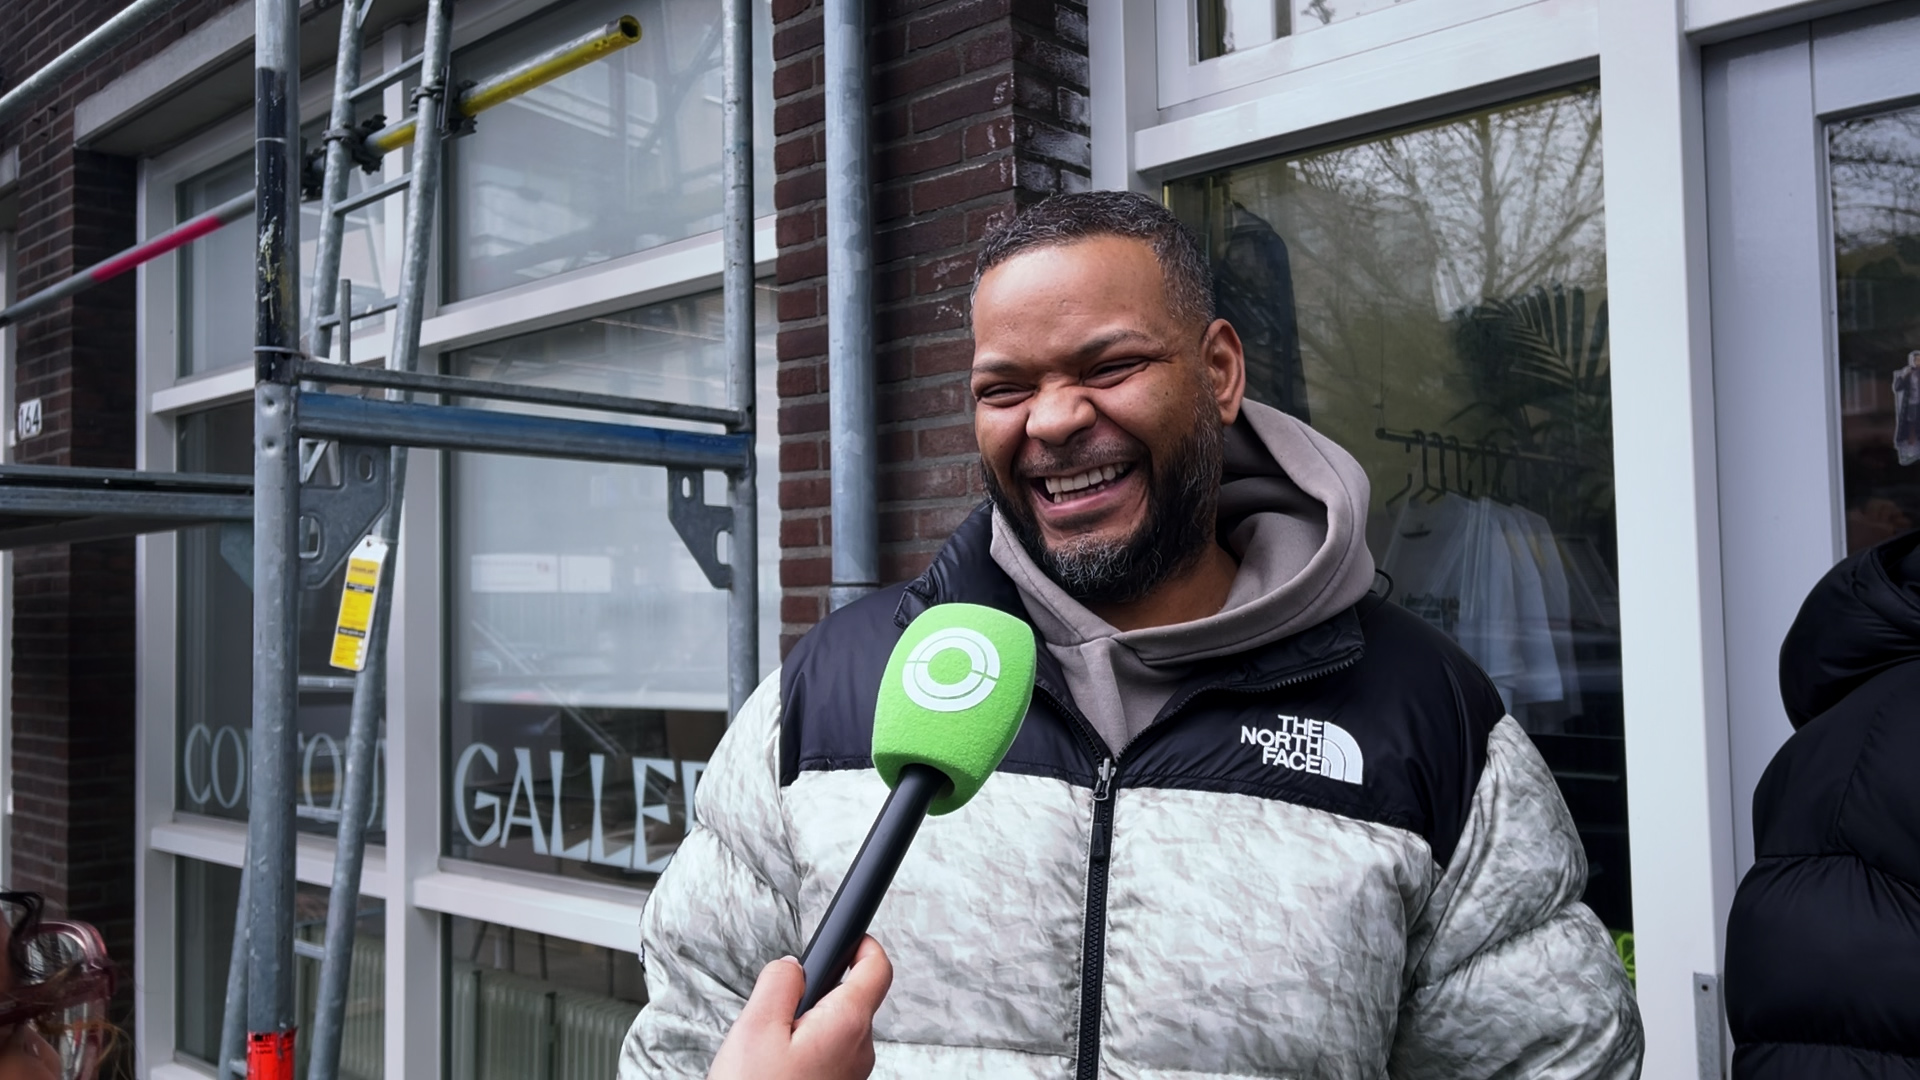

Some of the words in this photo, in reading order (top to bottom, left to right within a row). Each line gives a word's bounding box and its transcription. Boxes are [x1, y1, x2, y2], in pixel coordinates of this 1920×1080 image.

[20, 403, 40, 436] 164
[1277, 714, 1323, 737] THE
[1240, 725, 1322, 756] NORTH
[1262, 746, 1322, 774] FACE
